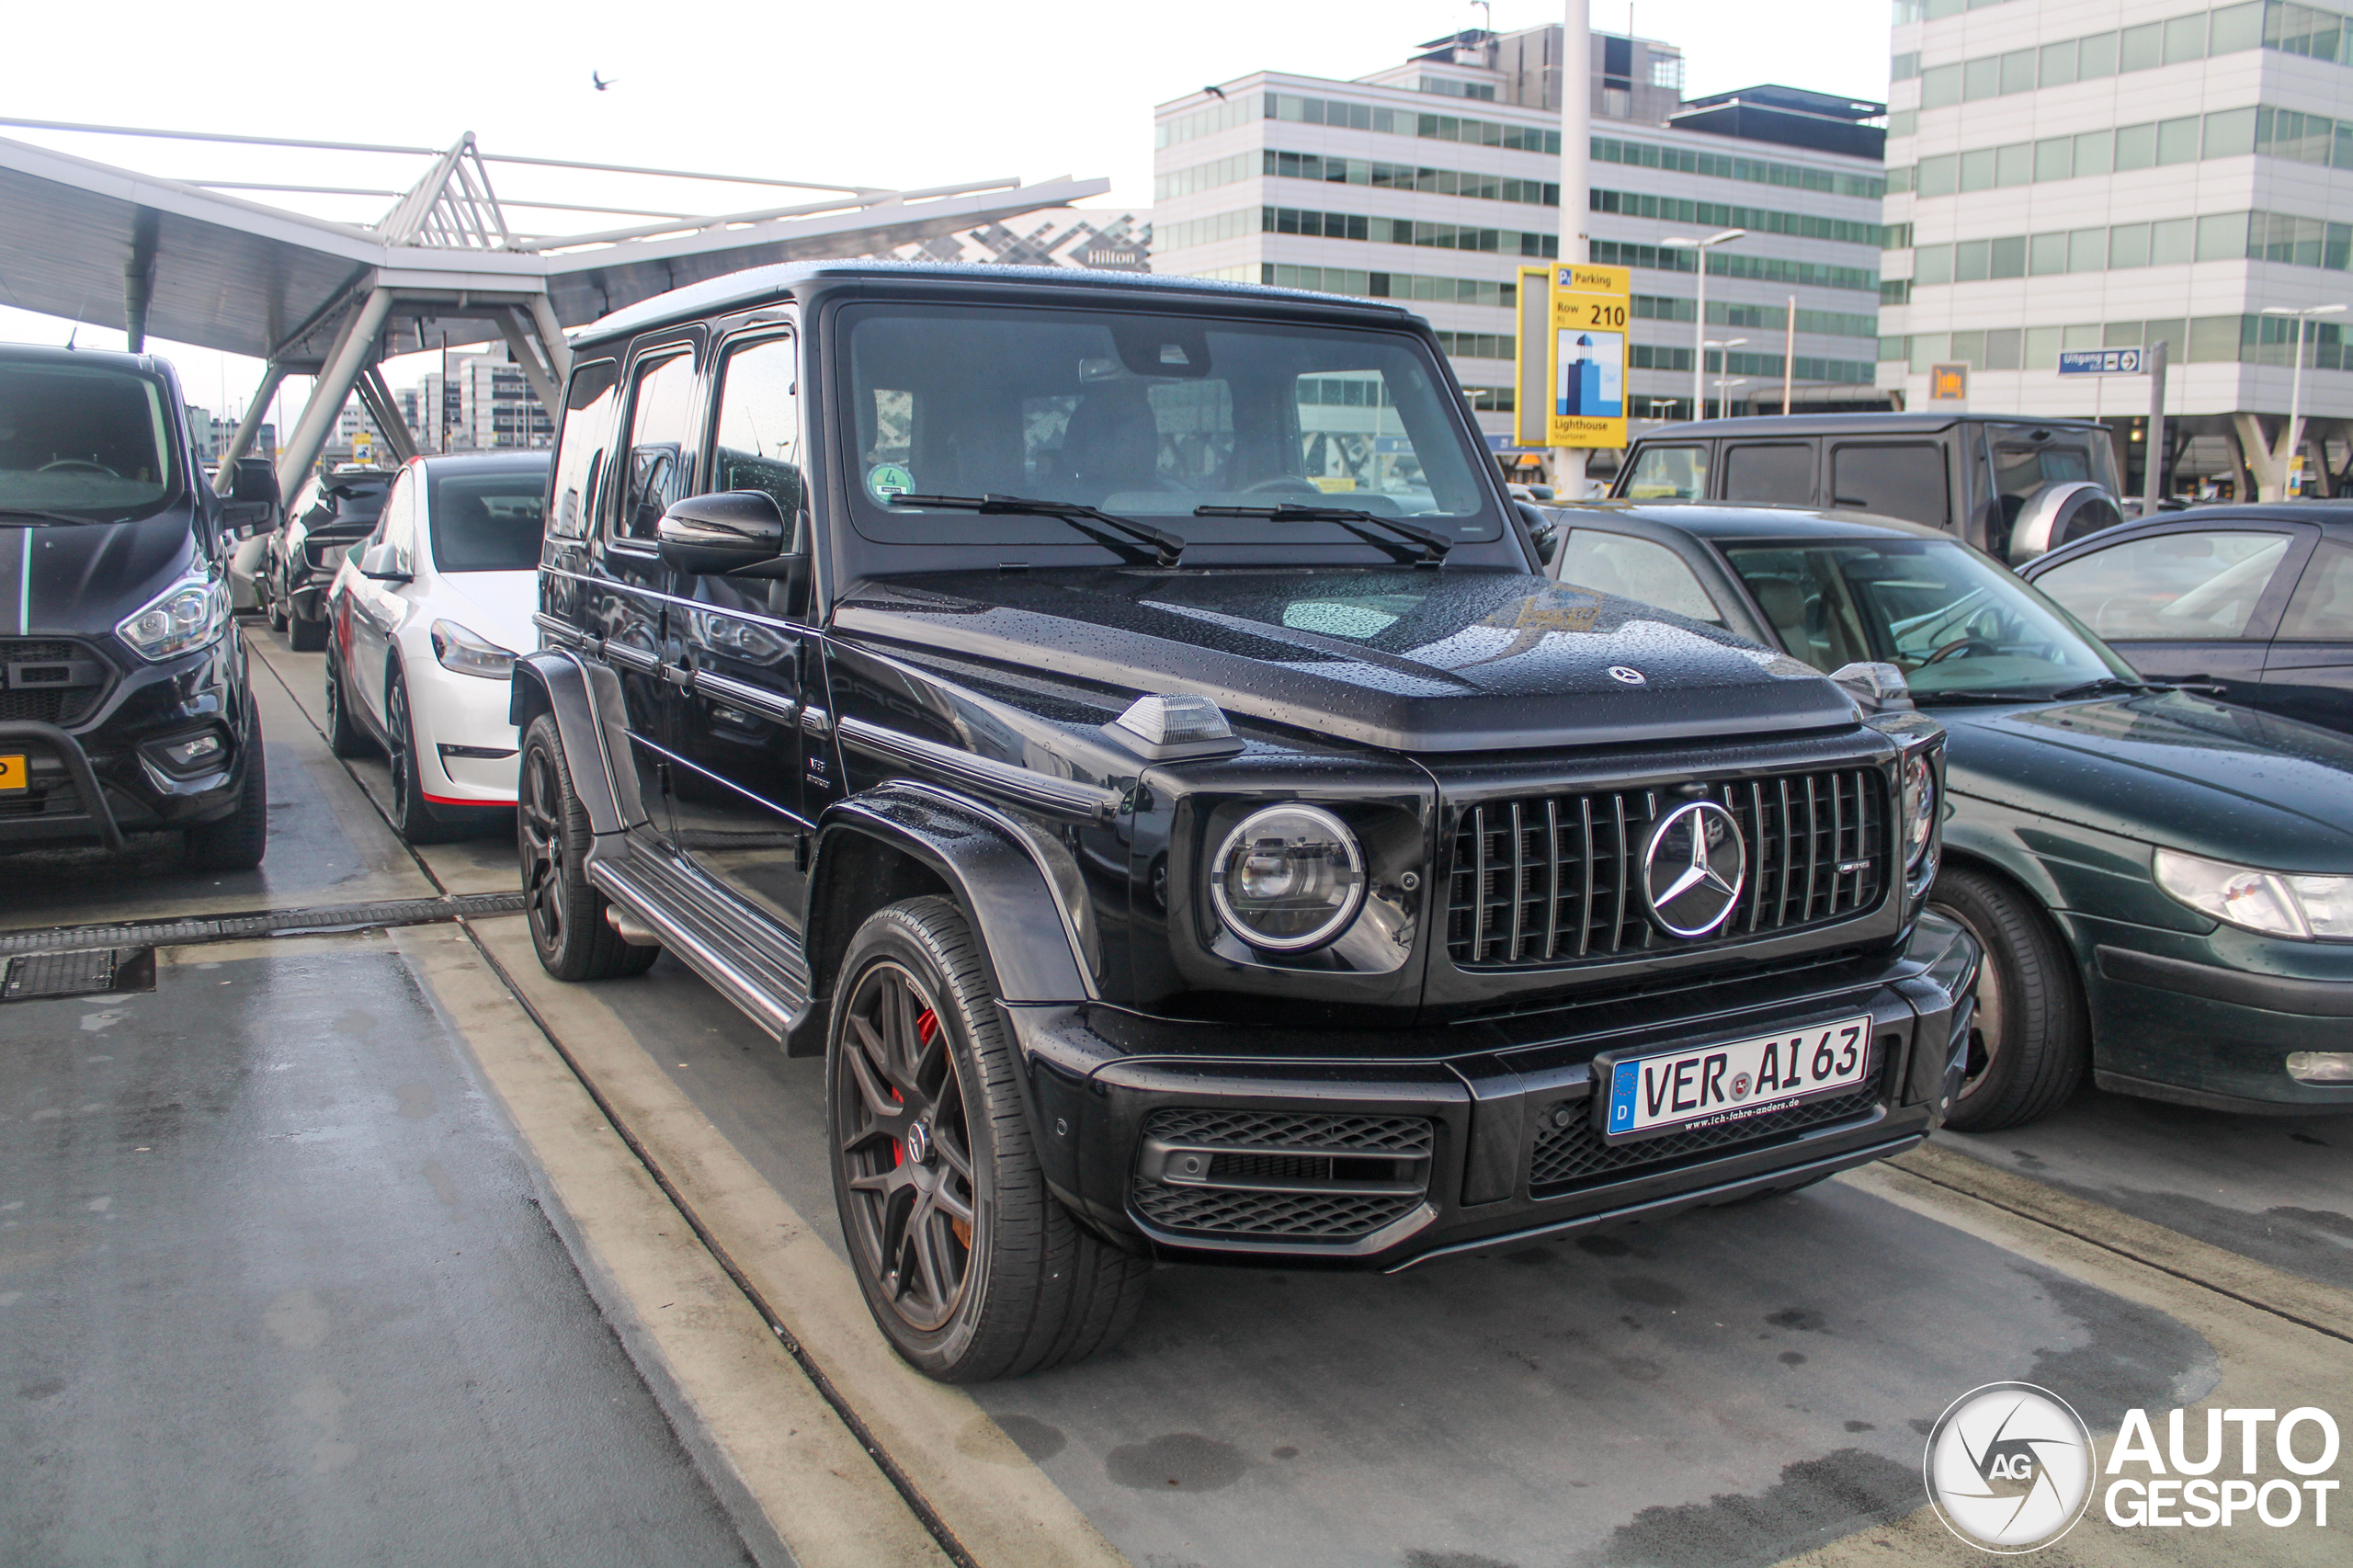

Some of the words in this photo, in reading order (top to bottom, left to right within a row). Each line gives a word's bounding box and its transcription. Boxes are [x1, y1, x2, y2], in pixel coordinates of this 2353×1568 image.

[1088, 250, 1136, 266] Hilton
[1575, 272, 1611, 289] Parking
[1558, 301, 1580, 313] Row
[1591, 304, 1626, 326] 210
[2063, 353, 2103, 366] Uitgang
[1555, 418, 1608, 432] Lighthouse
[885, 470, 897, 485] 4
[1644, 1052, 1728, 1118] VER
[1755, 1038, 1802, 1096] AI
[1812, 1026, 1860, 1082] 63
[1617, 1105, 1628, 1120] D
[1685, 1098, 1801, 1131] www.ich-fahre-anders.de
